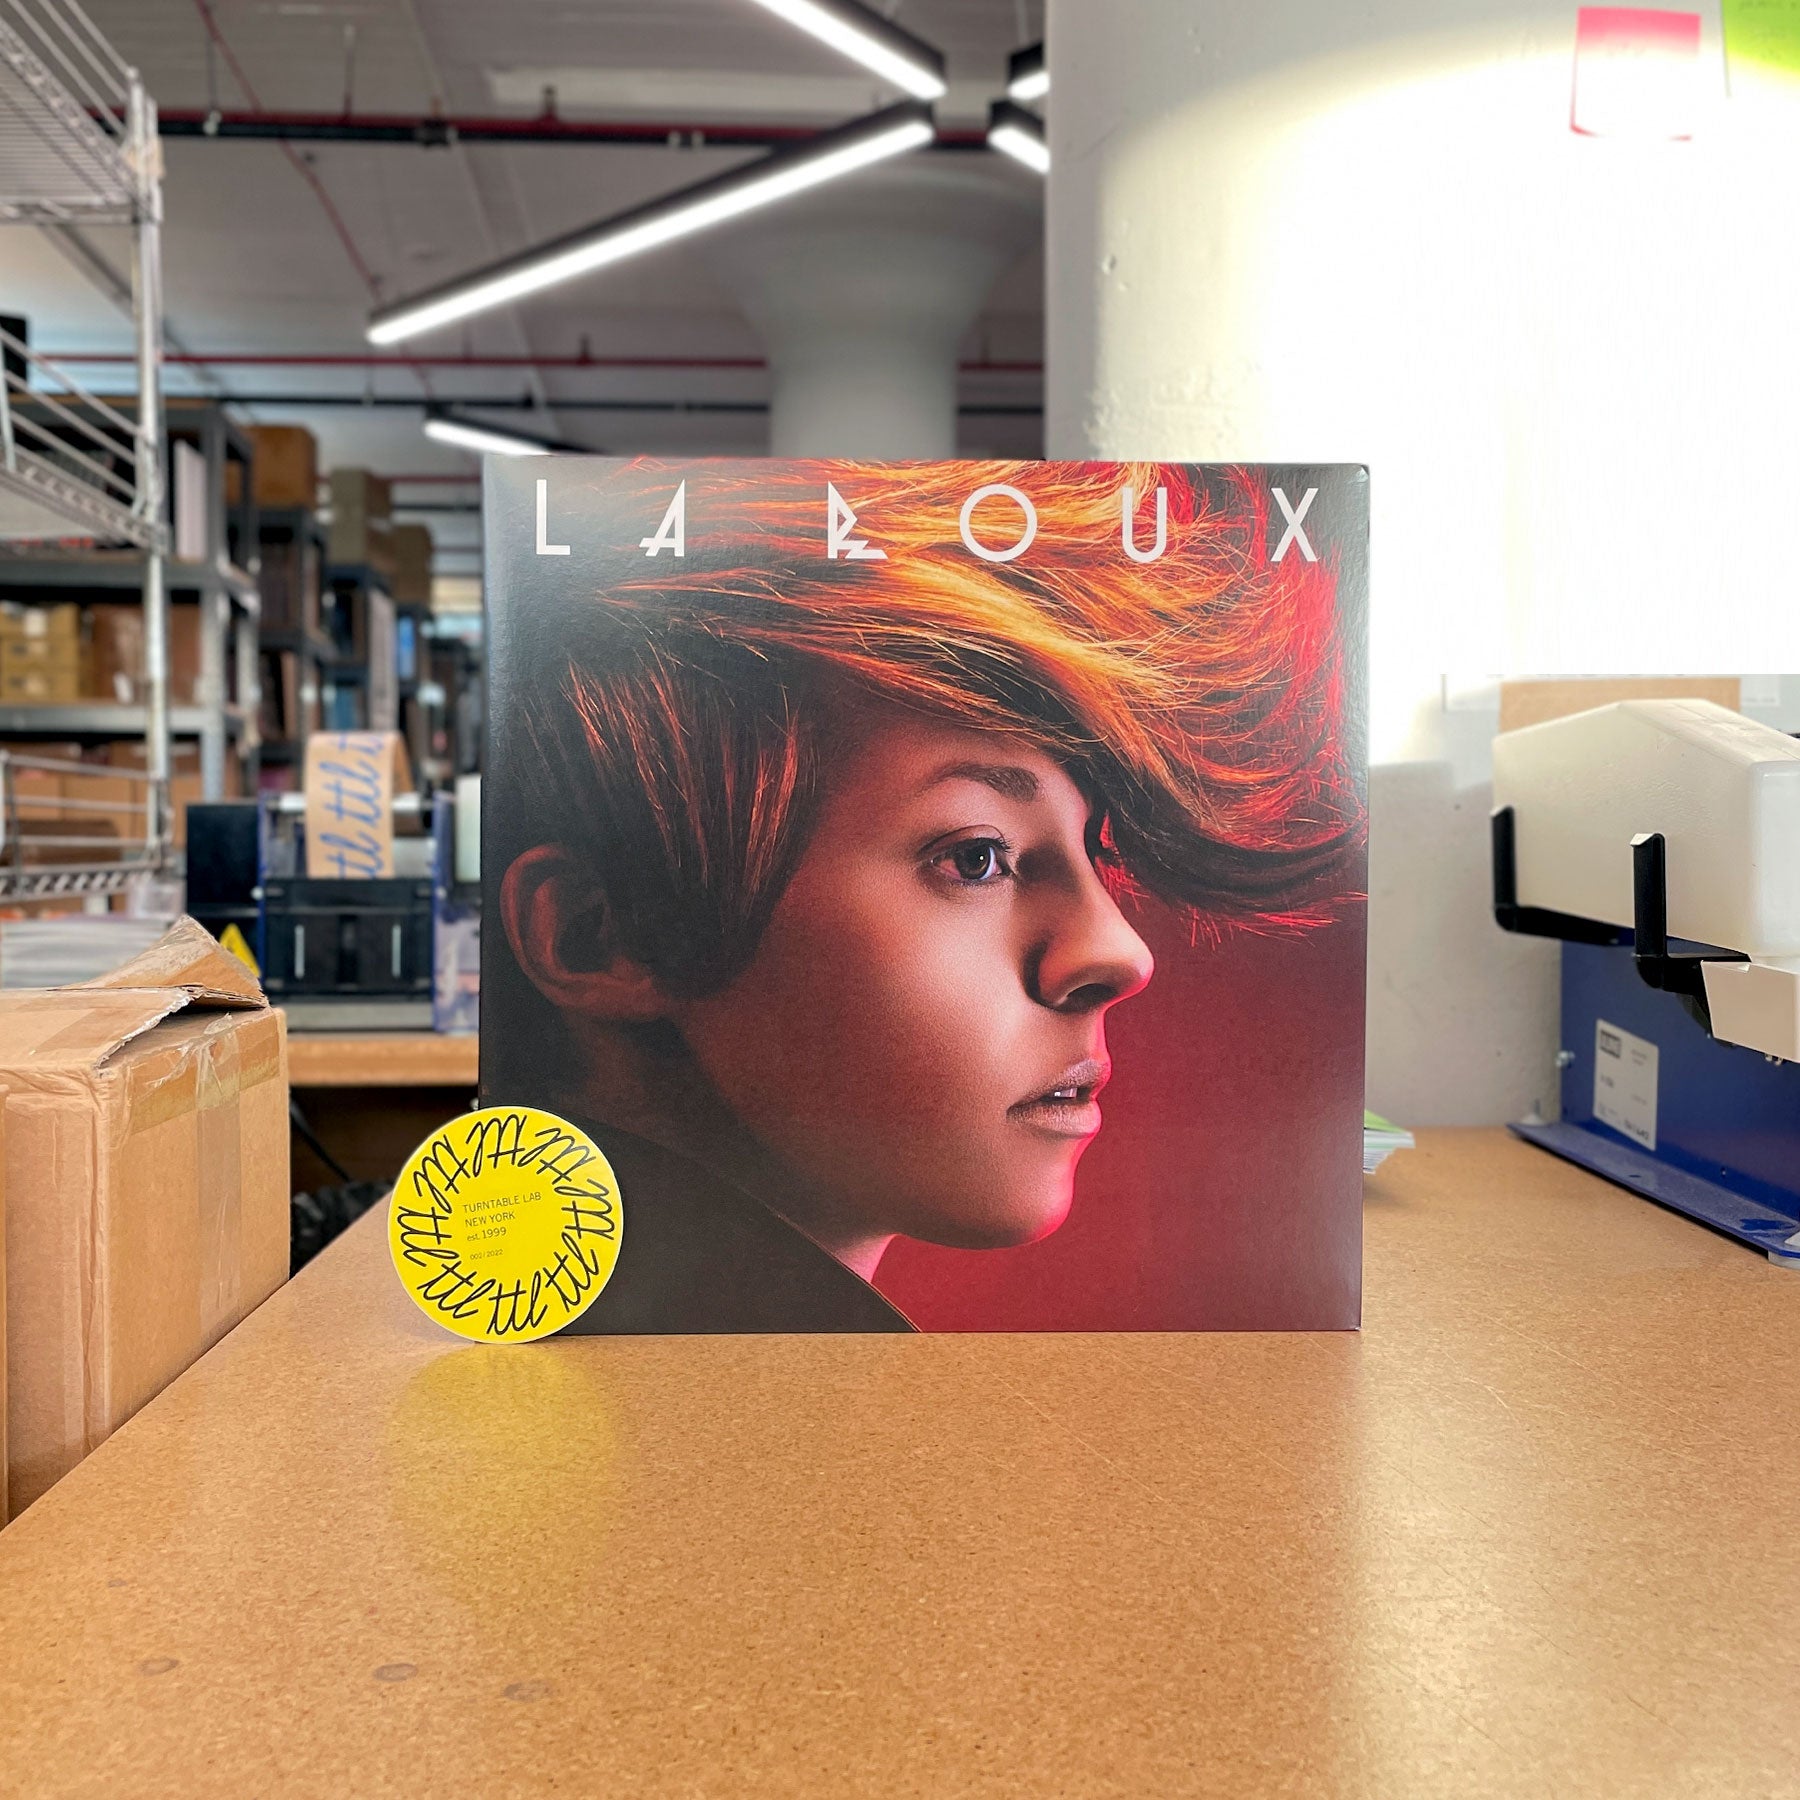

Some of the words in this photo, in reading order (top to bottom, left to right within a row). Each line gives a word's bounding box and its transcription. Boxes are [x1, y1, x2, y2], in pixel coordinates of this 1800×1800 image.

[535, 478, 686, 558] LA
[827, 480, 1321, 563] ROUX
[463, 1195, 520, 1213] TURNTABLE
[523, 1192, 542, 1203] LAB
[465, 1215, 487, 1228] NEW
[489, 1211, 516, 1223] YORK
[482, 1226, 507, 1239] 1999
